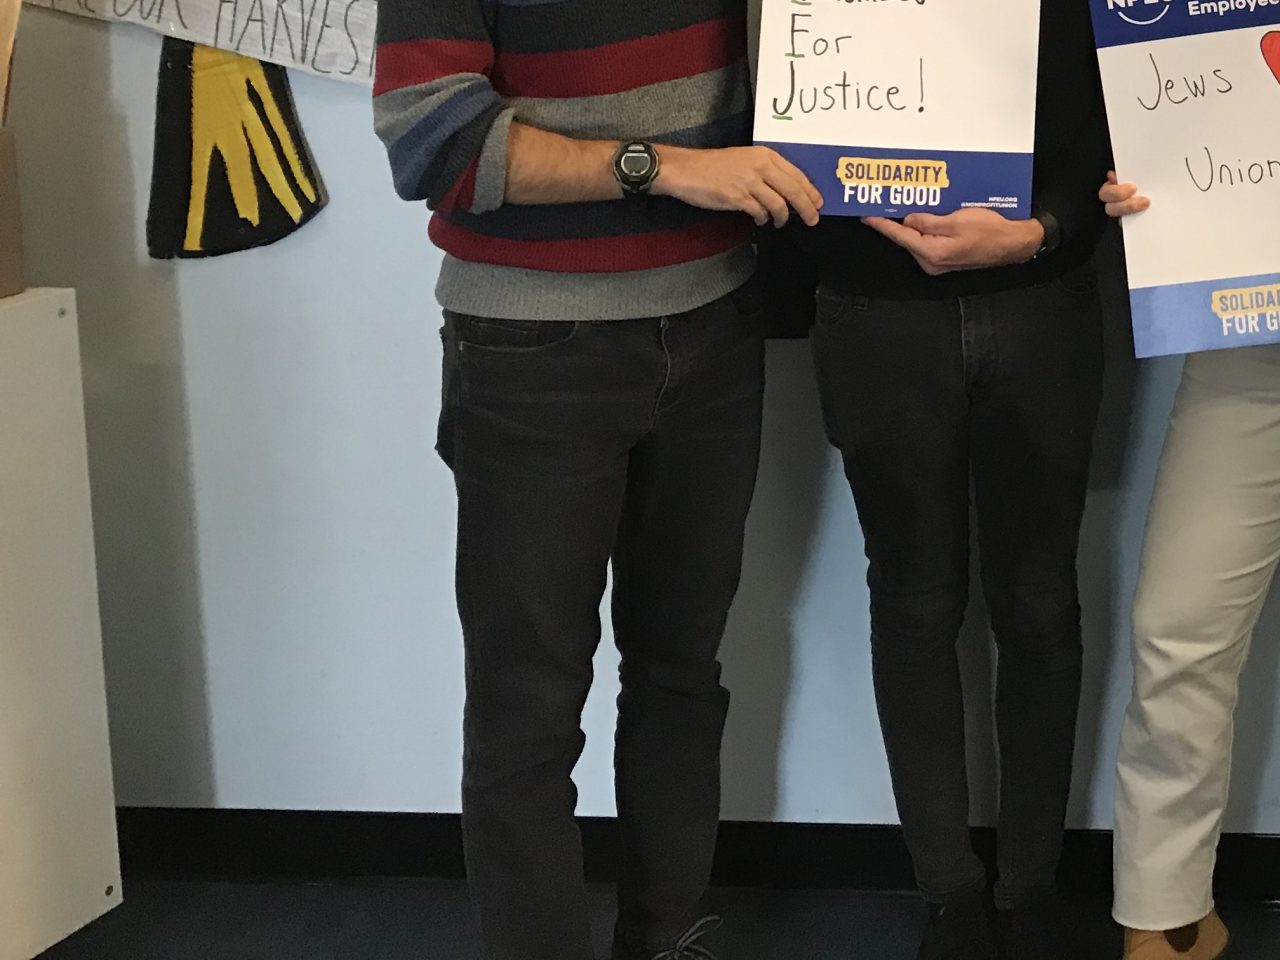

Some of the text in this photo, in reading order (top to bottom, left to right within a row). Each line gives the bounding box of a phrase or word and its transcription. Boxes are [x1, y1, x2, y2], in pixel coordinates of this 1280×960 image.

[790, 14, 853, 56] For
[772, 57, 926, 116] Justice!
[1137, 53, 1233, 111] Jews
[845, 162, 942, 183] SOLIDARITY
[843, 183, 940, 206] FOR GOOD
[1222, 314, 1259, 337] FOR
